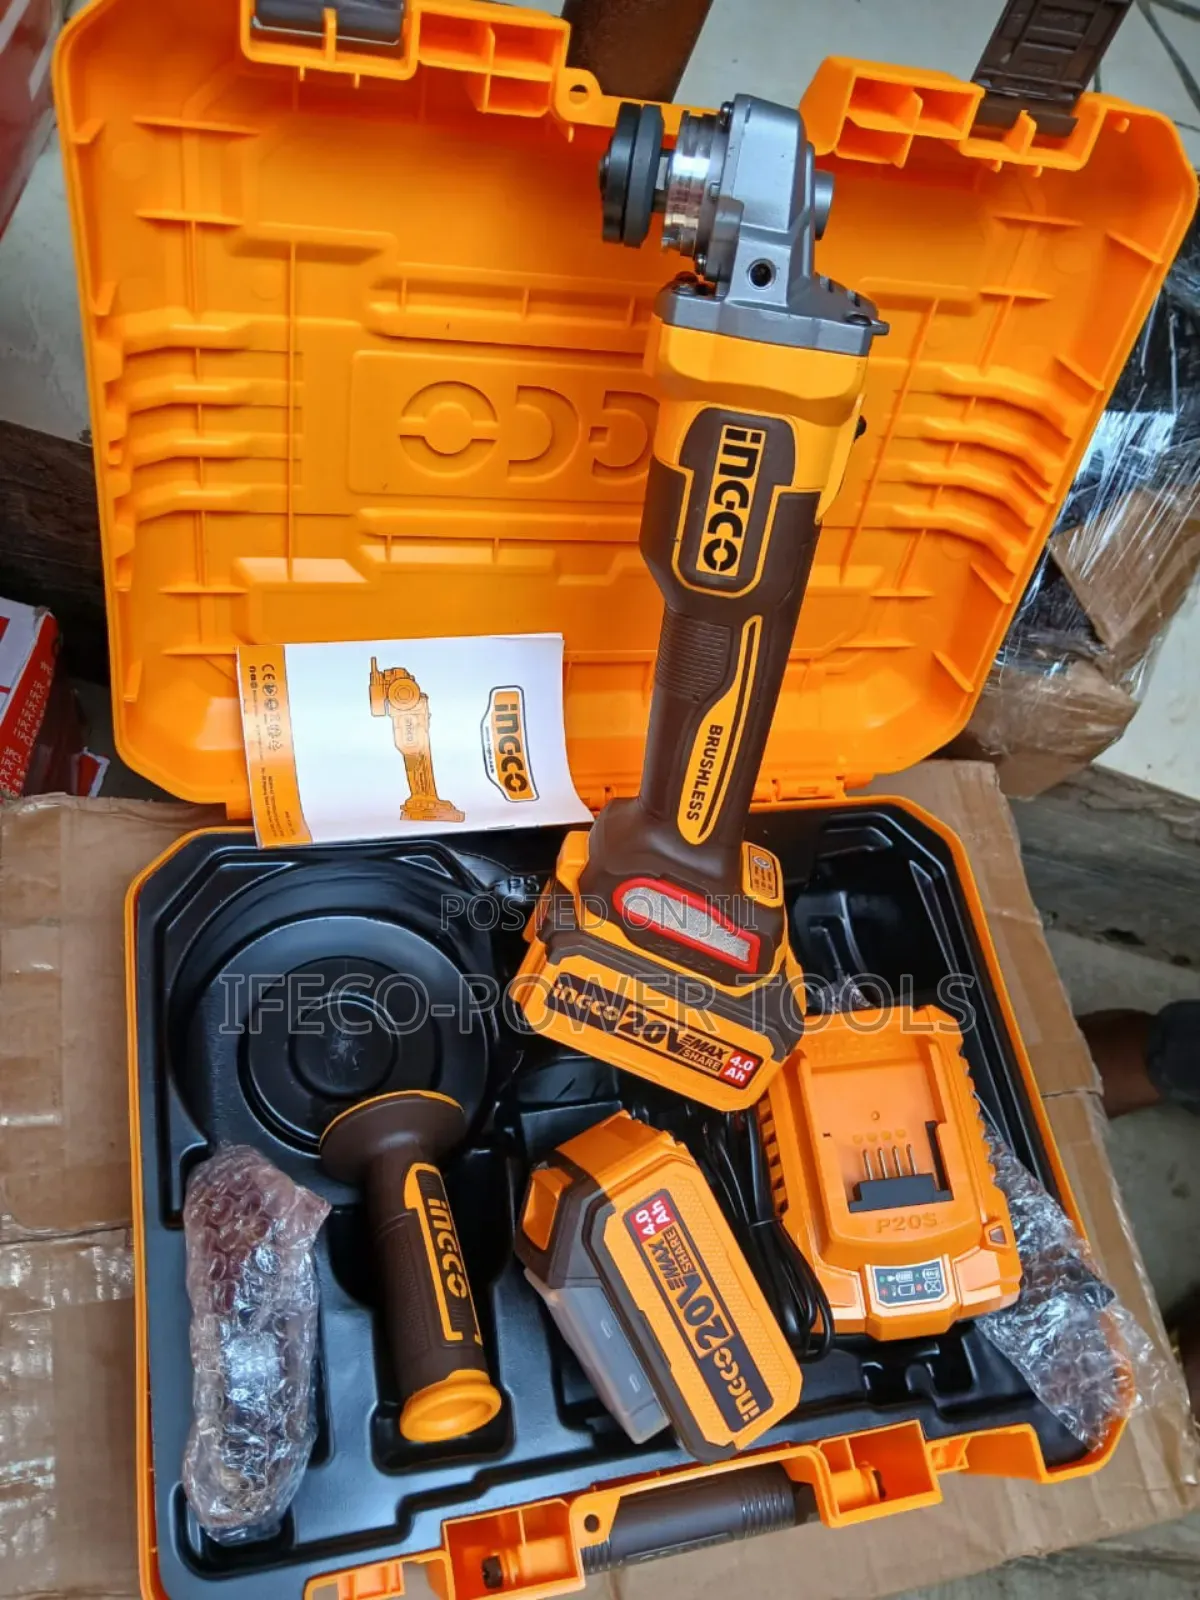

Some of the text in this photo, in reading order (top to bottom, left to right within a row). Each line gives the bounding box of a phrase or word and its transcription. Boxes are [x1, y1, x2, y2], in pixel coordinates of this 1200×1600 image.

[686, 724, 724, 821] BRUSHLESS
[617, 1010, 686, 1055] 20V
[681, 1049, 723, 1072] SHARE
[729, 1055, 754, 1071] 4.0
[724, 1067, 746, 1082] Ah
[635, 1209, 656, 1236] 4.0
[651, 1199, 671, 1225] Ah
[875, 1211, 938, 1234] P20S
[662, 1226, 695, 1275] SHARE
[676, 1272, 730, 1351] 20V
